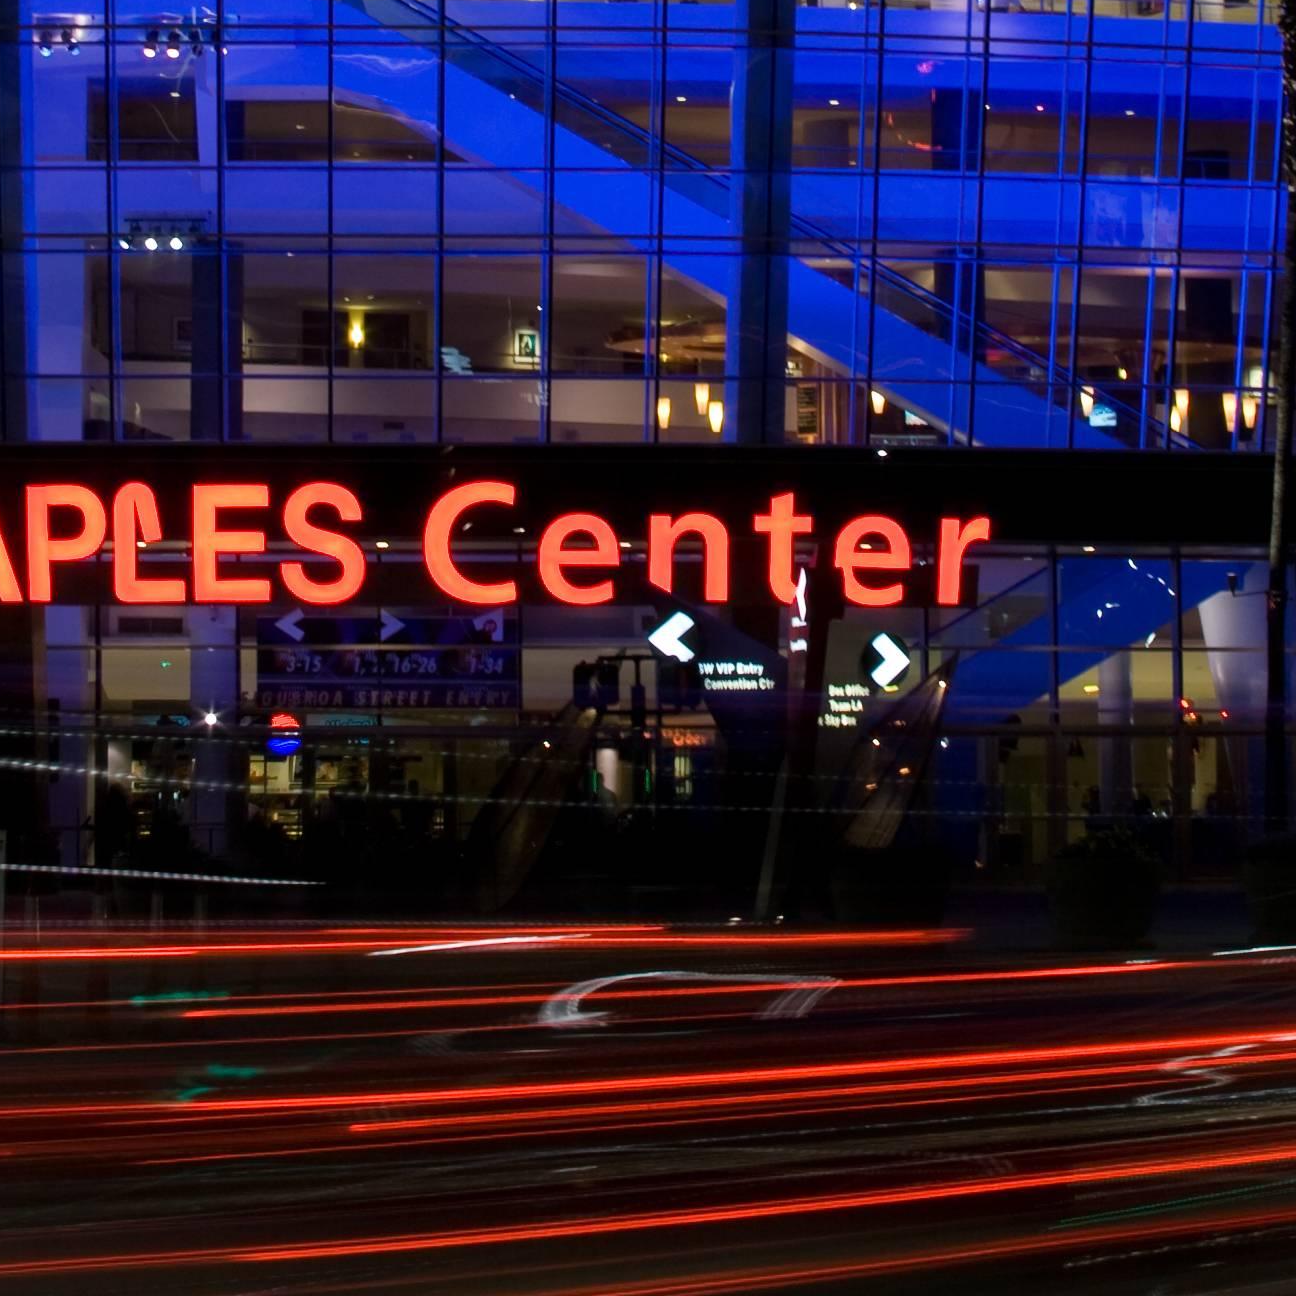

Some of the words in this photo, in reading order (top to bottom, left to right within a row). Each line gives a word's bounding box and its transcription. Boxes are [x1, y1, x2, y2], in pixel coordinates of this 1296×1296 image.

[424, 480, 990, 605] Center
[286, 655, 322, 673] 3-15
[716, 662, 736, 675] VIP
[736, 662, 765, 677] Entry
[704, 677, 758, 691] Convention
[758, 677, 777, 690] Ctr
[844, 683, 870, 697] Office
[354, 688, 432, 706] STREET
[446, 688, 511, 706] ENTRY
